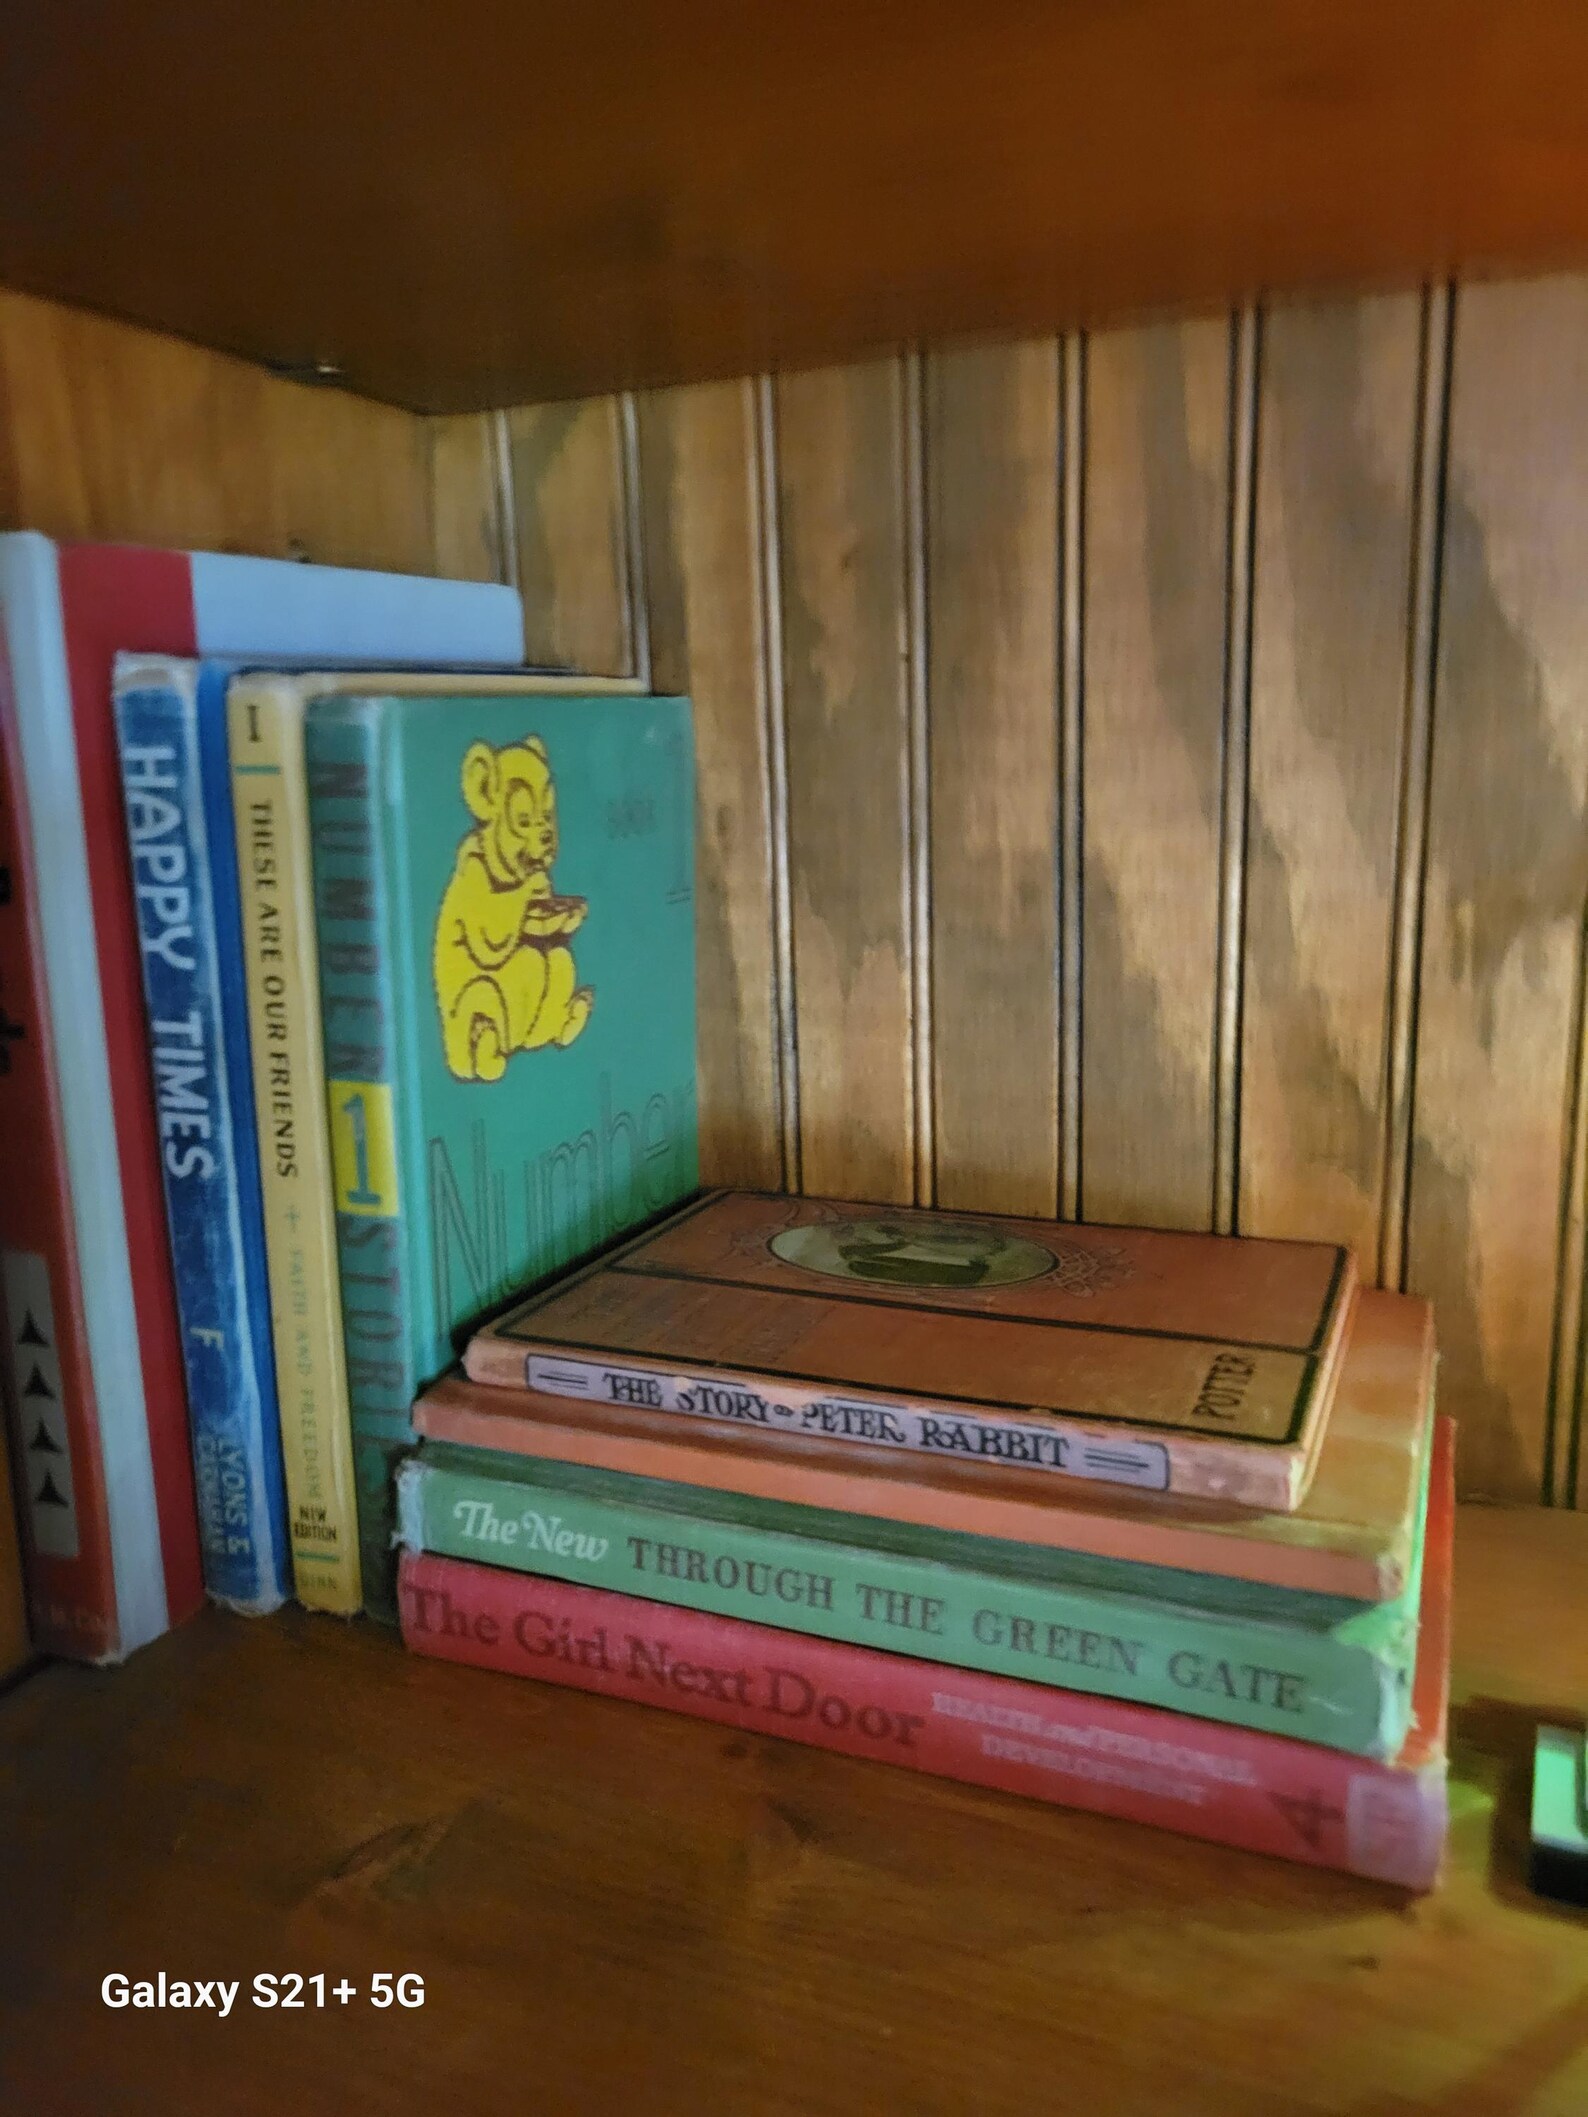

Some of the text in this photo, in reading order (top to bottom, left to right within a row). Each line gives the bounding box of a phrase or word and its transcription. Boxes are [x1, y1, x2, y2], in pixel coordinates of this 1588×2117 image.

[123, 747, 215, 1180] HAPPY TIMES
[251, 802, 298, 1177] THESE ARE OUR FRIENDS
[342, 1094, 382, 1204] 1
[602, 1372, 664, 1407] THE
[675, 1384, 769, 1423] STORY
[801, 1402, 907, 1443] PETER
[915, 1415, 1070, 1469] RABBIT
[1190, 1353, 1256, 1422] POTTER
[293, 1521, 338, 1543] EDITION
[299, 1504, 327, 1522] NEW
[452, 1499, 1308, 1714] The New THROUGH THE GREEN GATE
[403, 1583, 926, 1750] The Girl Next Door
